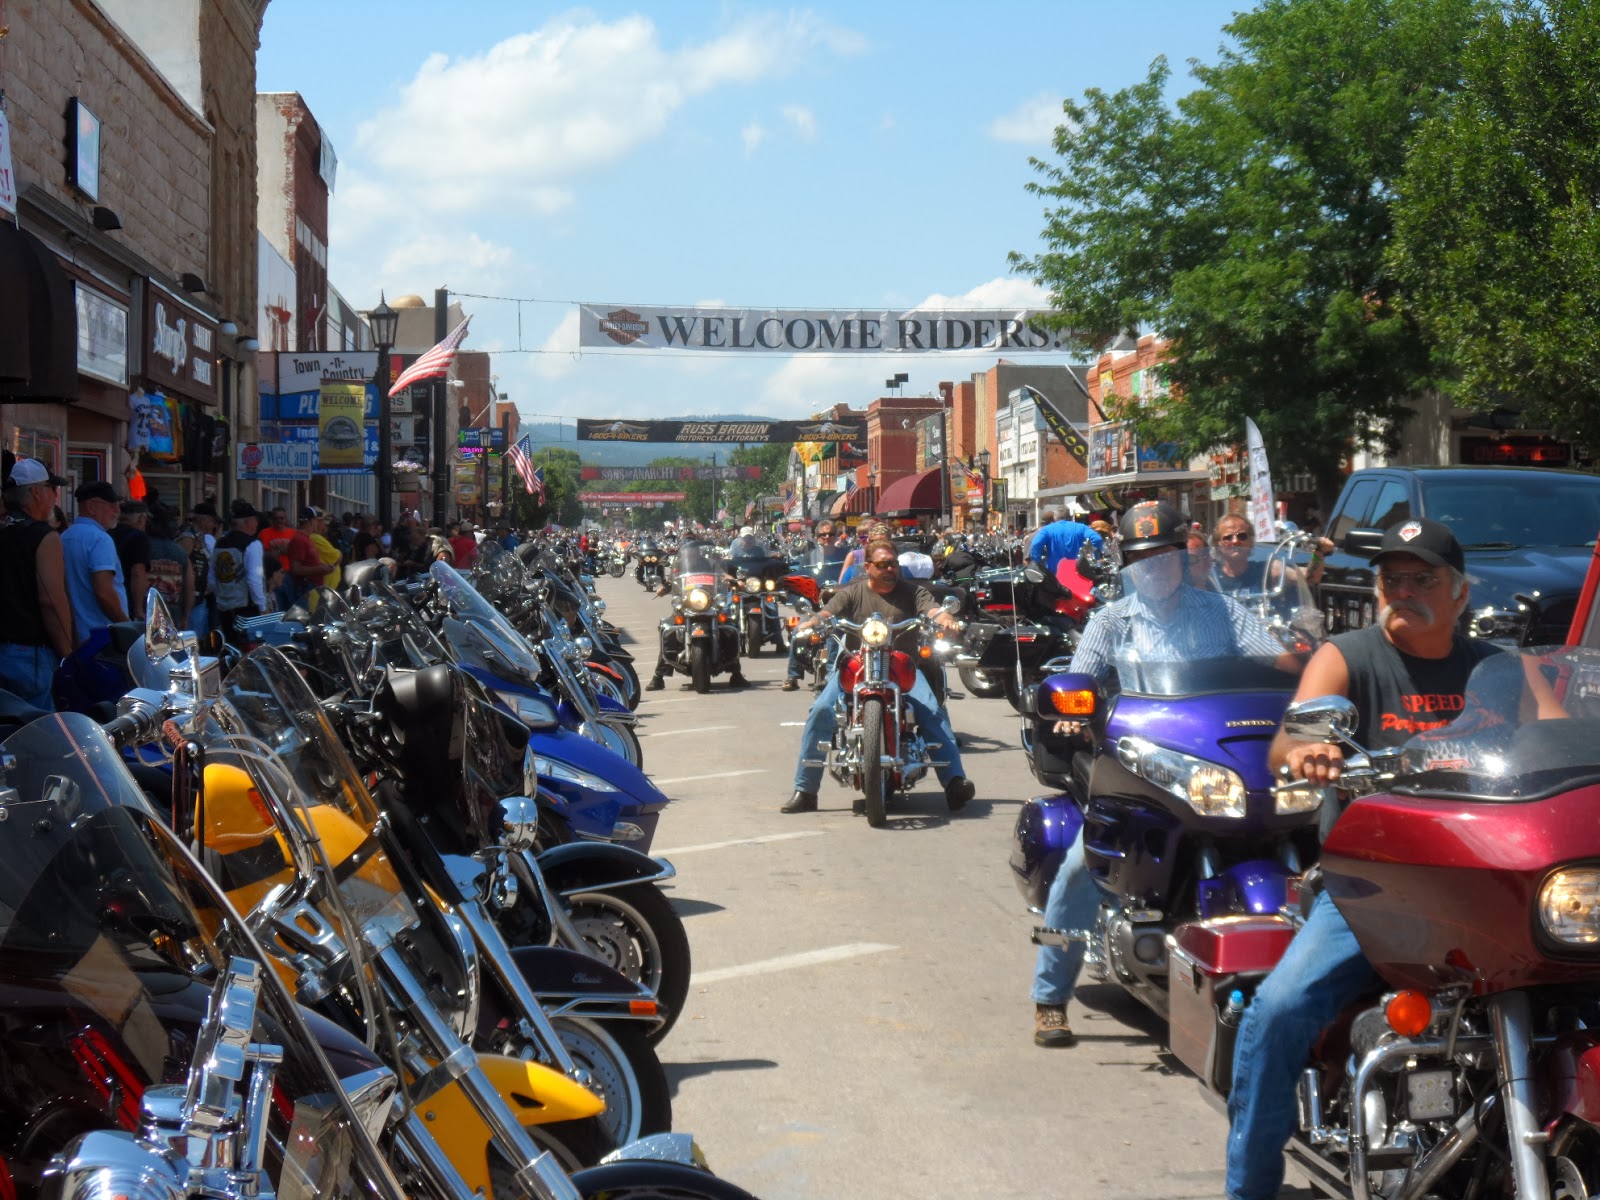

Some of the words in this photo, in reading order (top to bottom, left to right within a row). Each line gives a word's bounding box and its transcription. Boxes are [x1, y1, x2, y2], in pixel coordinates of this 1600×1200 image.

[602, 321, 646, 332] HARLEY-DAVIDSON
[656, 315, 882, 349] WELCOME
[293, 358, 320, 375] Town
[323, 367, 364, 380] Country
[322, 396, 363, 405] WELCOME
[681, 423, 715, 435] RUSS
[717, 424, 771, 435] BROWN
[588, 432, 648, 441] 1-800-4-BIKERS
[675, 434, 723, 442] MOTORCYCLE
[724, 434, 770, 442] ATTORNEYS
[797, 432, 858, 441] 1-800-4-BIKERS
[266, 446, 308, 468] WebCam
[602, 468, 625, 481] SONS
[632, 467, 675, 480] ANARCHY
[1401, 694, 1466, 713] SPEED
[1225, 719, 1276, 728] HONDA
